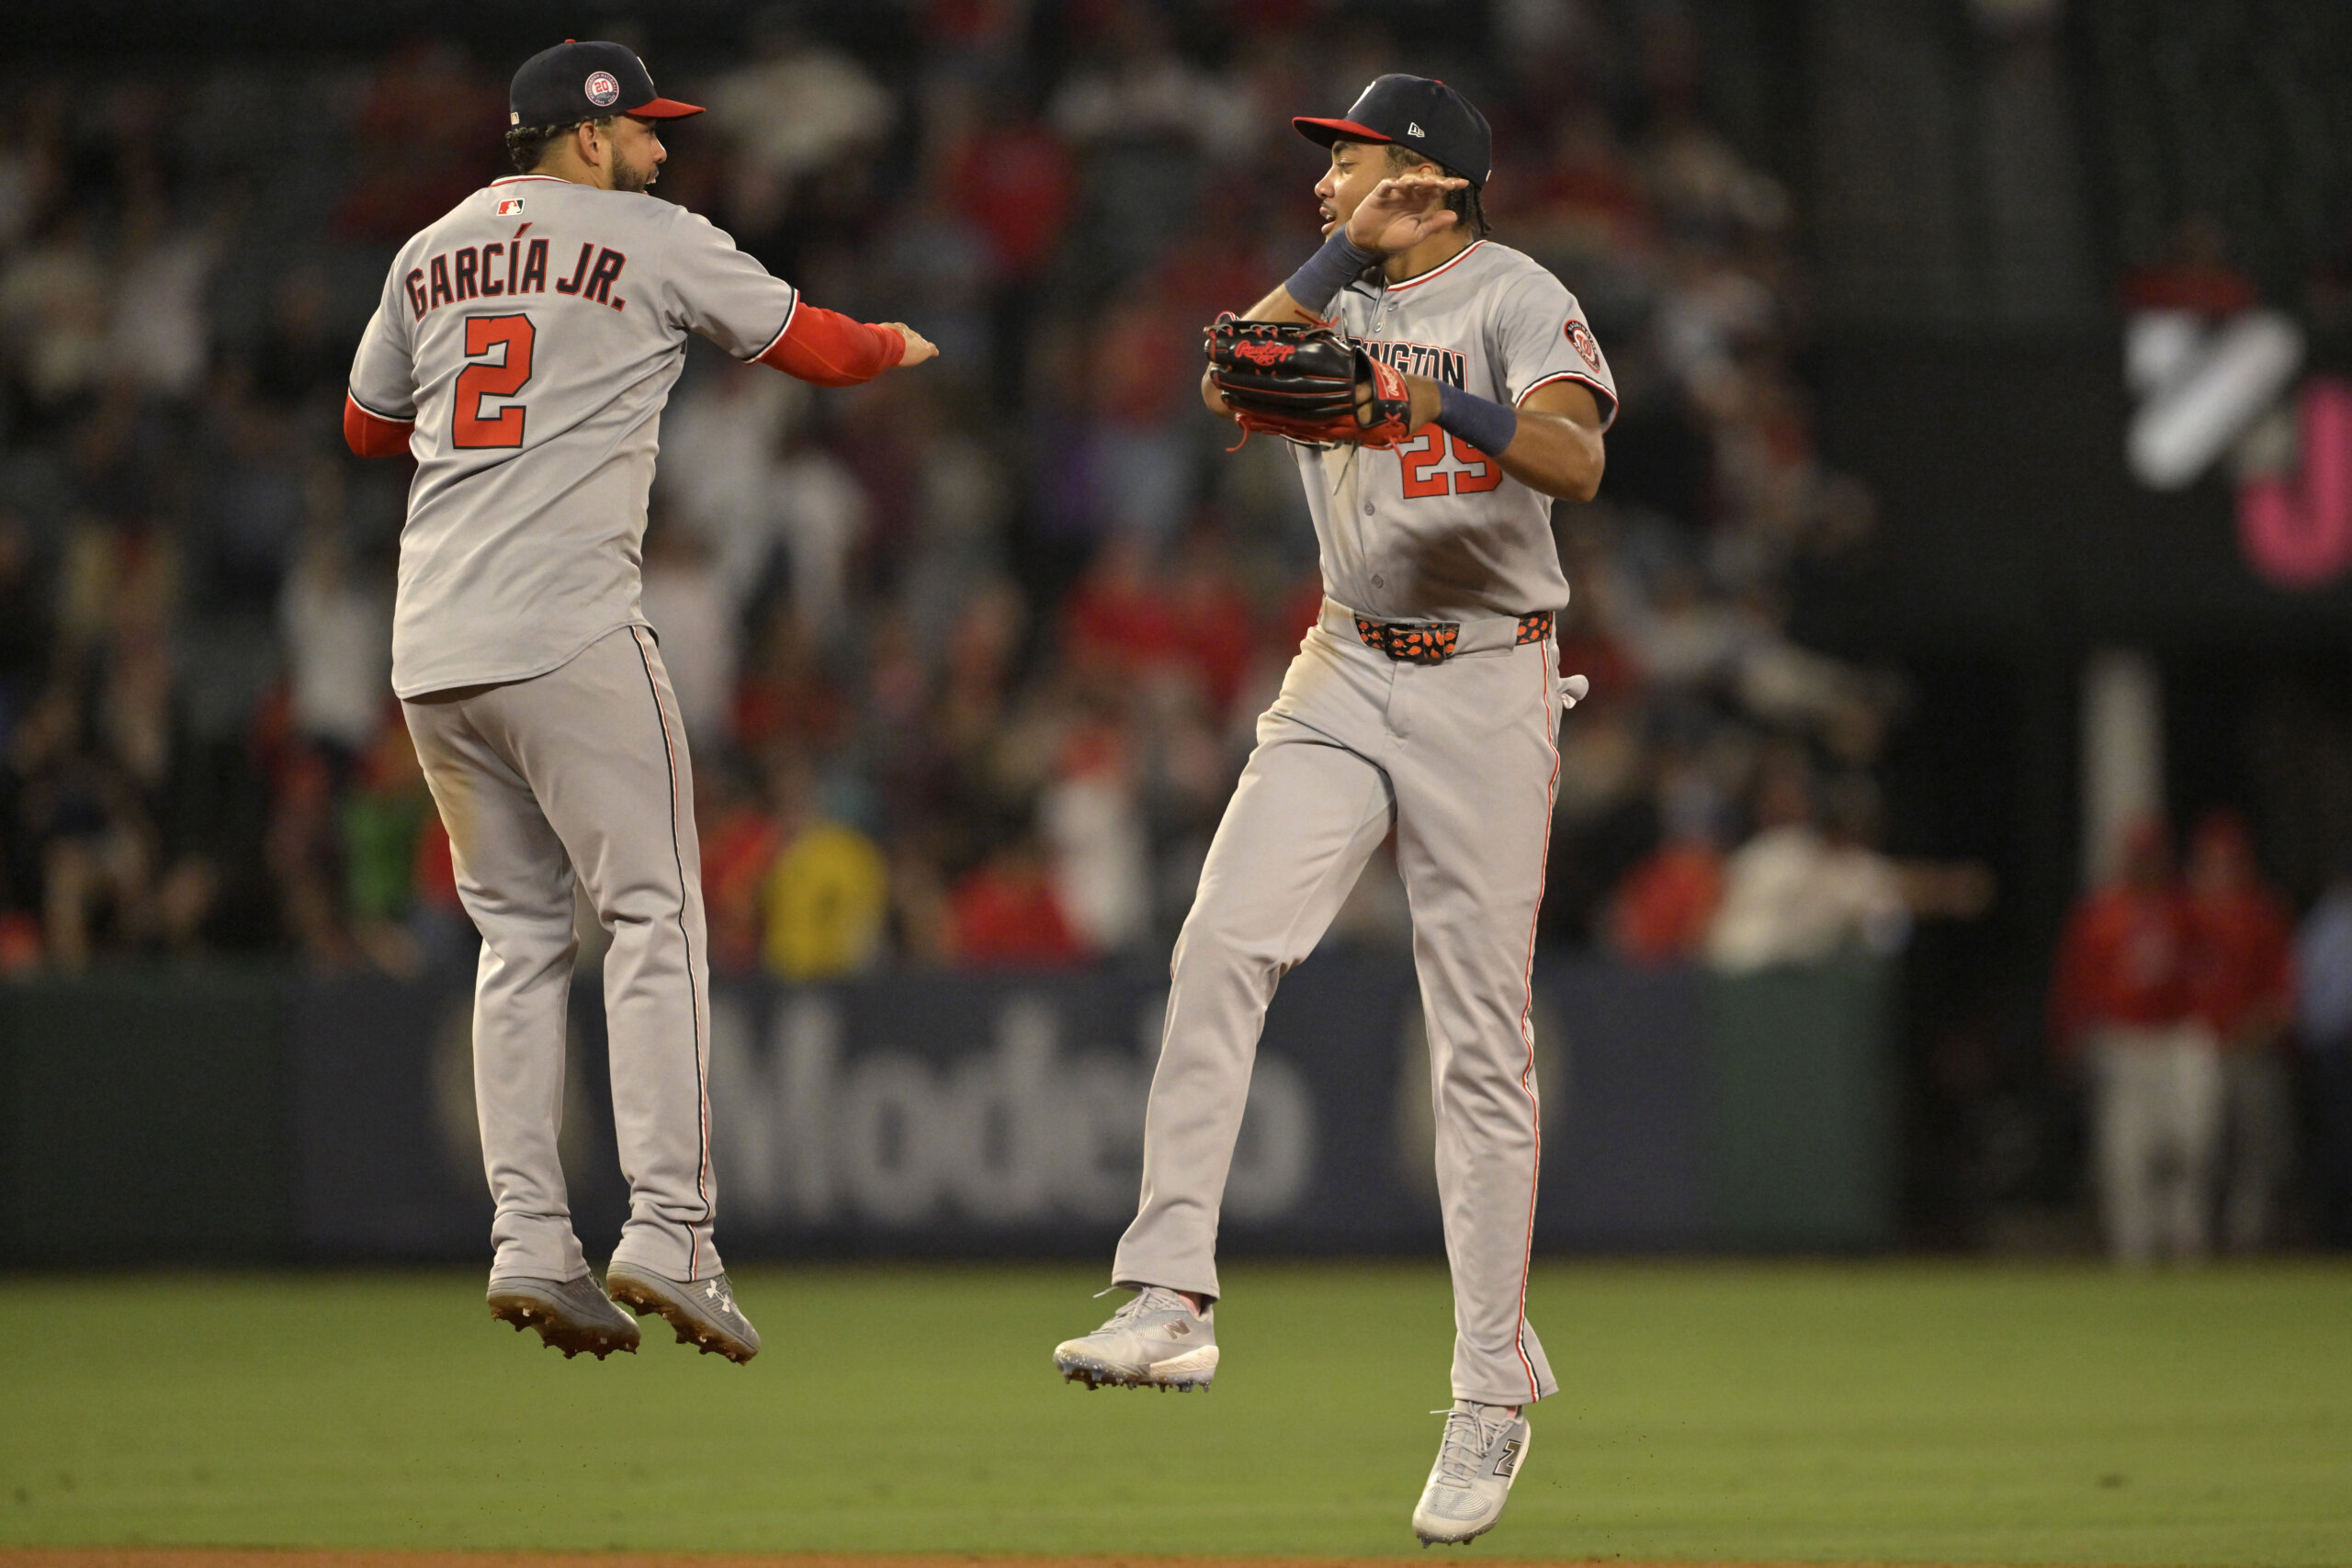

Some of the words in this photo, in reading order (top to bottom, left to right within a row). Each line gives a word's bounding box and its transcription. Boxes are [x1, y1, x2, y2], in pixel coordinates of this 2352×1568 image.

[594, 80, 609, 93] 20
[405, 222, 549, 322] GARCÍA
[556, 243, 626, 311] JR.
[452, 313, 536, 449] 2
[1235, 340, 1295, 363] Rawlings
